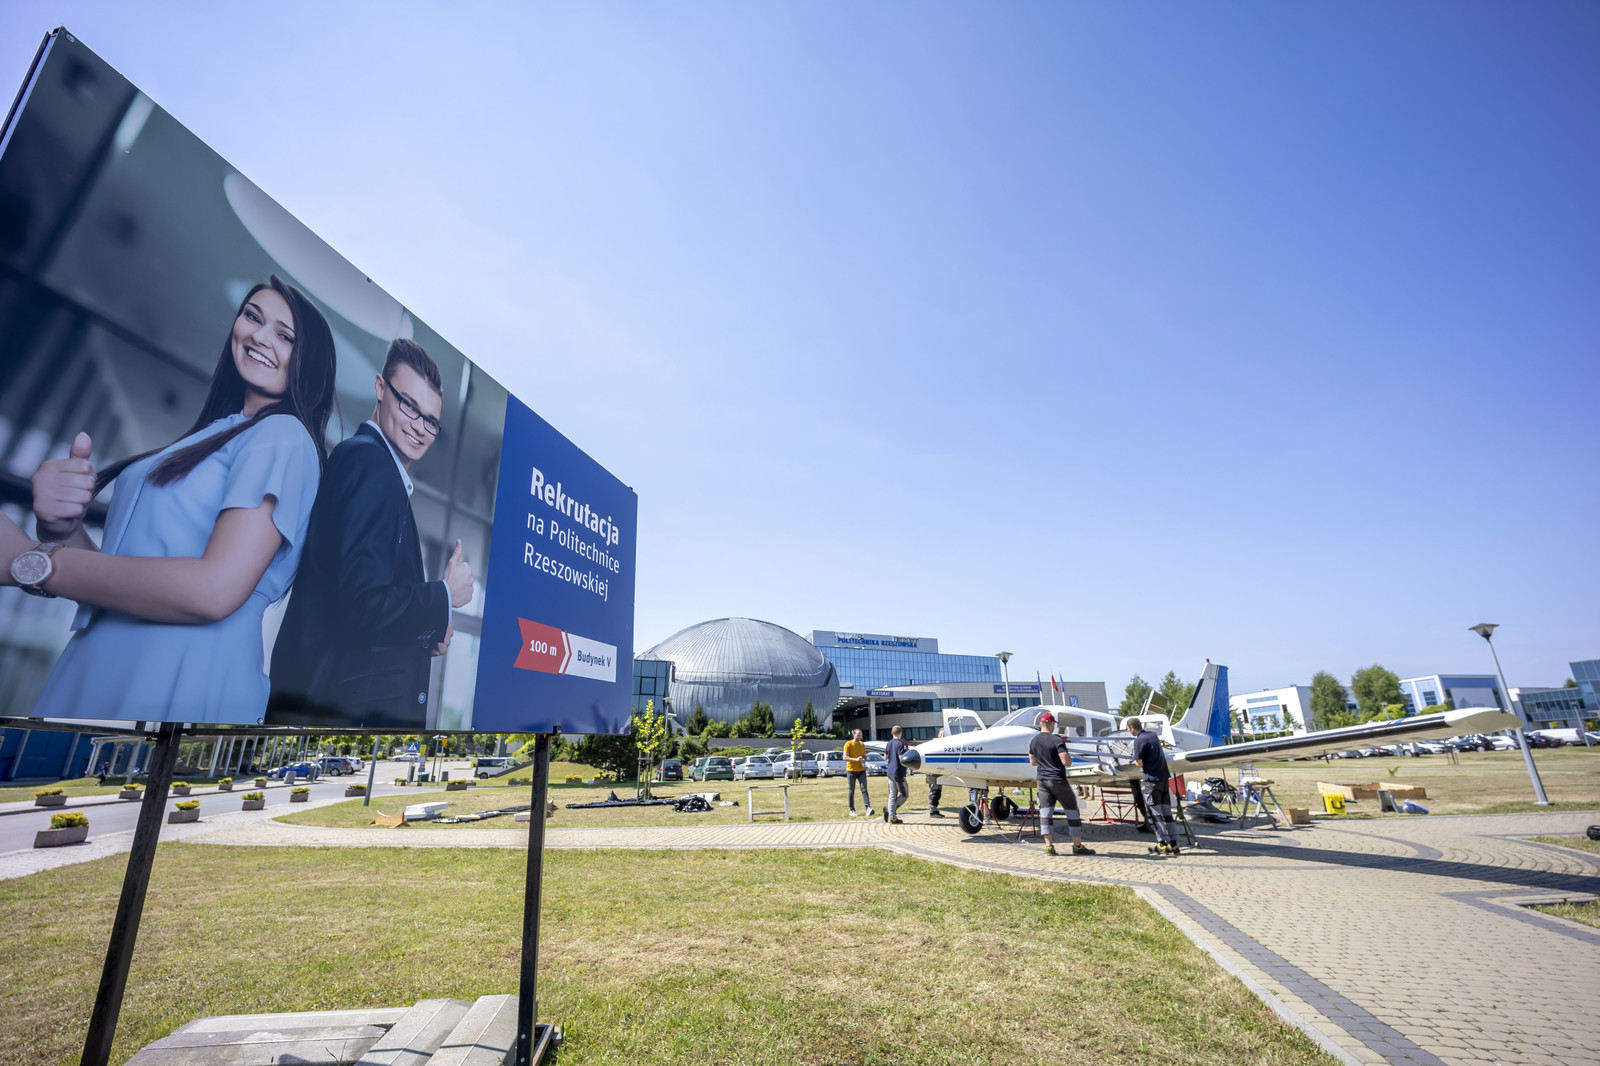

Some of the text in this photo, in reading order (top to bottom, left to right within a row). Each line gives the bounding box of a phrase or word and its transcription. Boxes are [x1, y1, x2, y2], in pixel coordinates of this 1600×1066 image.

[530, 467, 619, 546] Rekrutacja
[527, 512, 620, 575] na Politechnice
[524, 542, 609, 602] Rzeszowskiej
[530, 639, 557, 657] 100 m
[577, 649, 612, 668] Budynek V
[837, 637, 918, 648] POLITECHNIKA RZESZOWSKA
